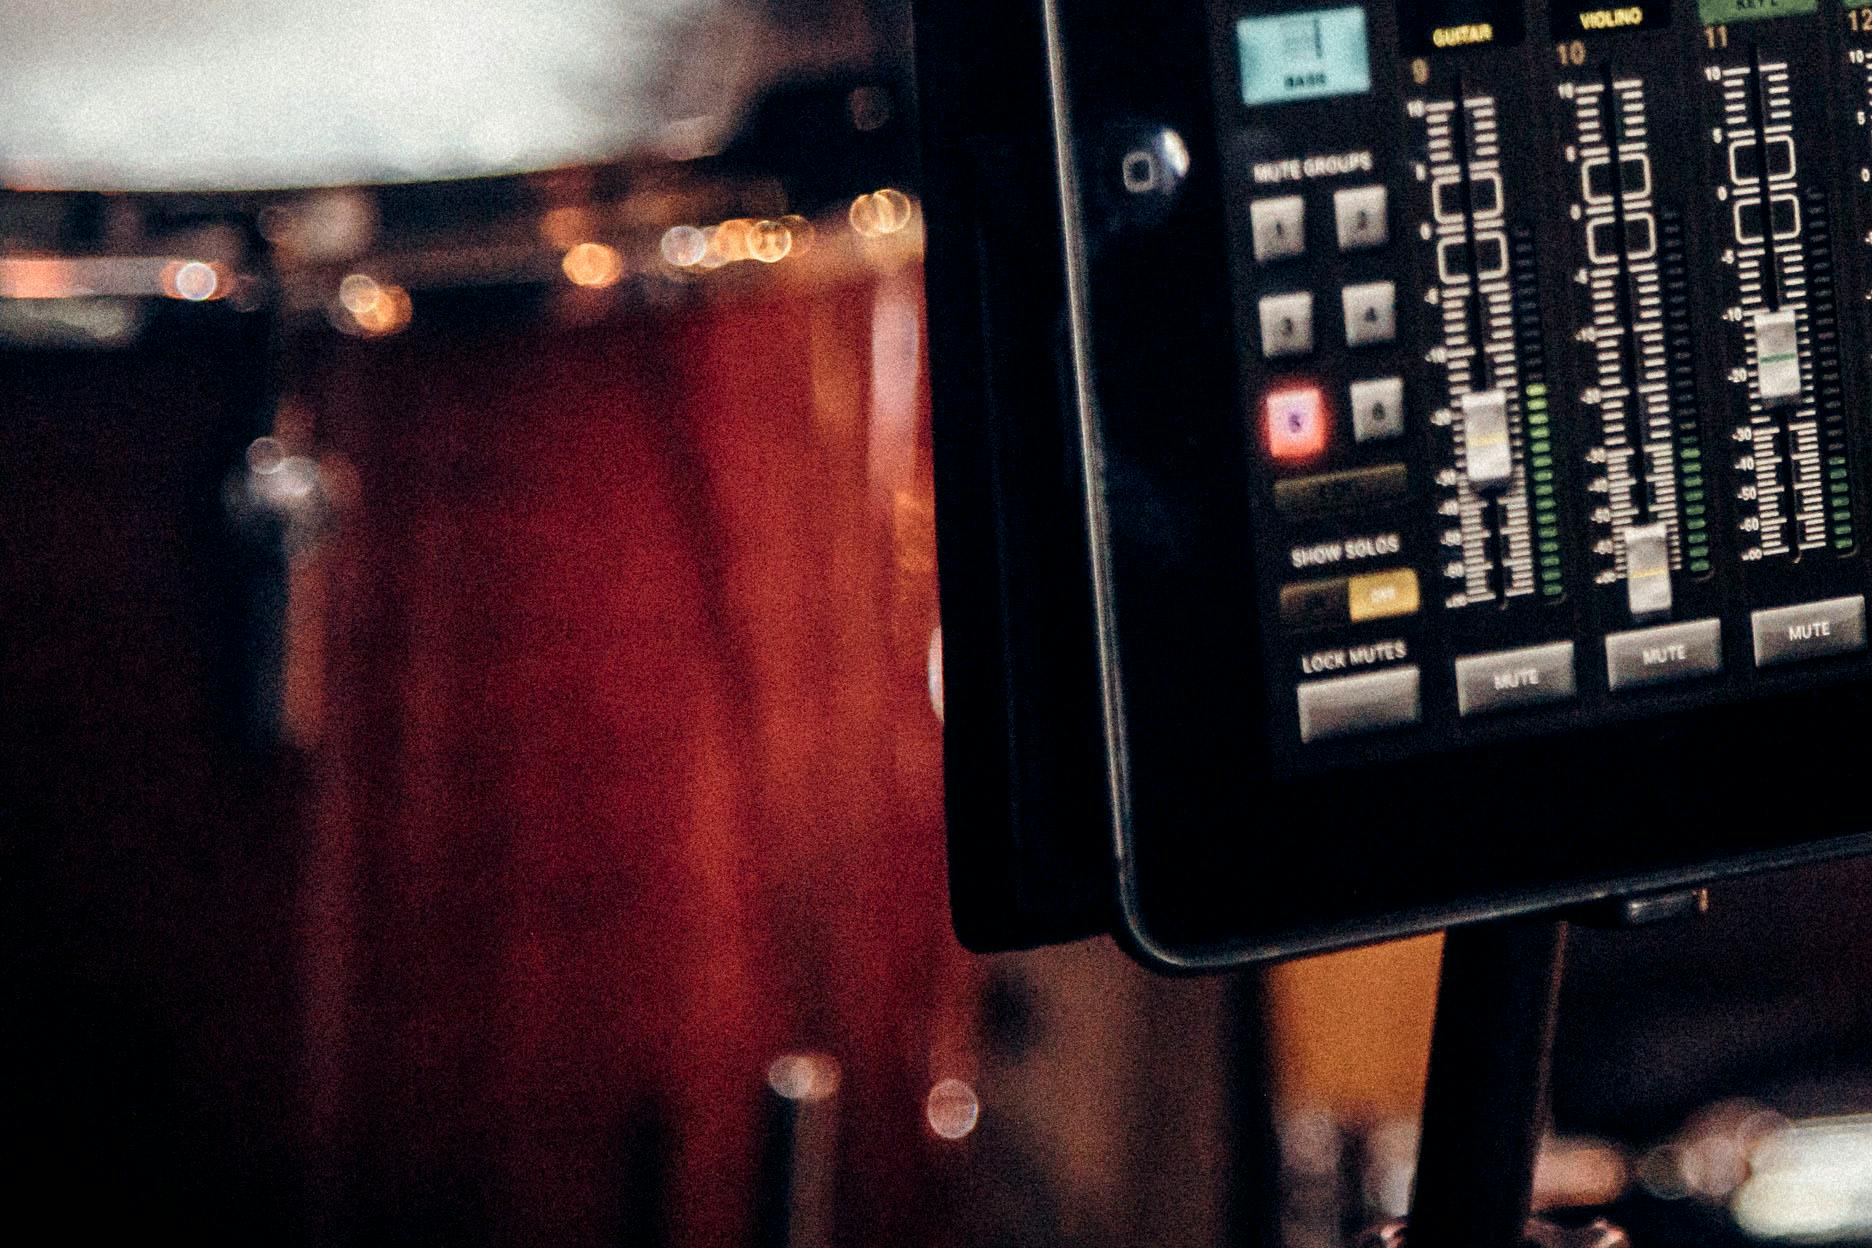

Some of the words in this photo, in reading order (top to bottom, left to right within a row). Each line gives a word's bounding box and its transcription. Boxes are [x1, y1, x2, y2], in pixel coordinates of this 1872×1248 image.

[1580, 6, 1643, 30] VIOLINO
[1433, 23, 1493, 47] GUITAR
[1704, 25, 1728, 49] 11
[1557, 39, 1586, 65] 10
[1850, 50, 1864, 64] 10
[1705, 66, 1721, 80] 10
[1857, 111, 1865, 125] 5
[1254, 159, 1301, 183] MUTE
[1303, 150, 1373, 178] GROUPS
[1861, 169, 1870, 182] 0
[1718, 186, 1727, 201] 0
[1737, 486, 1757, 500] -50
[1291, 542, 1342, 568] SHOW
[1344, 533, 1401, 559] SOLOS
[1789, 621, 1830, 641] MUTE
[1302, 651, 1345, 673] LOCK
[1349, 639, 1407, 665] MUTES
[1642, 645, 1687, 665] MUTE
[1494, 669, 1539, 690] MUTE
